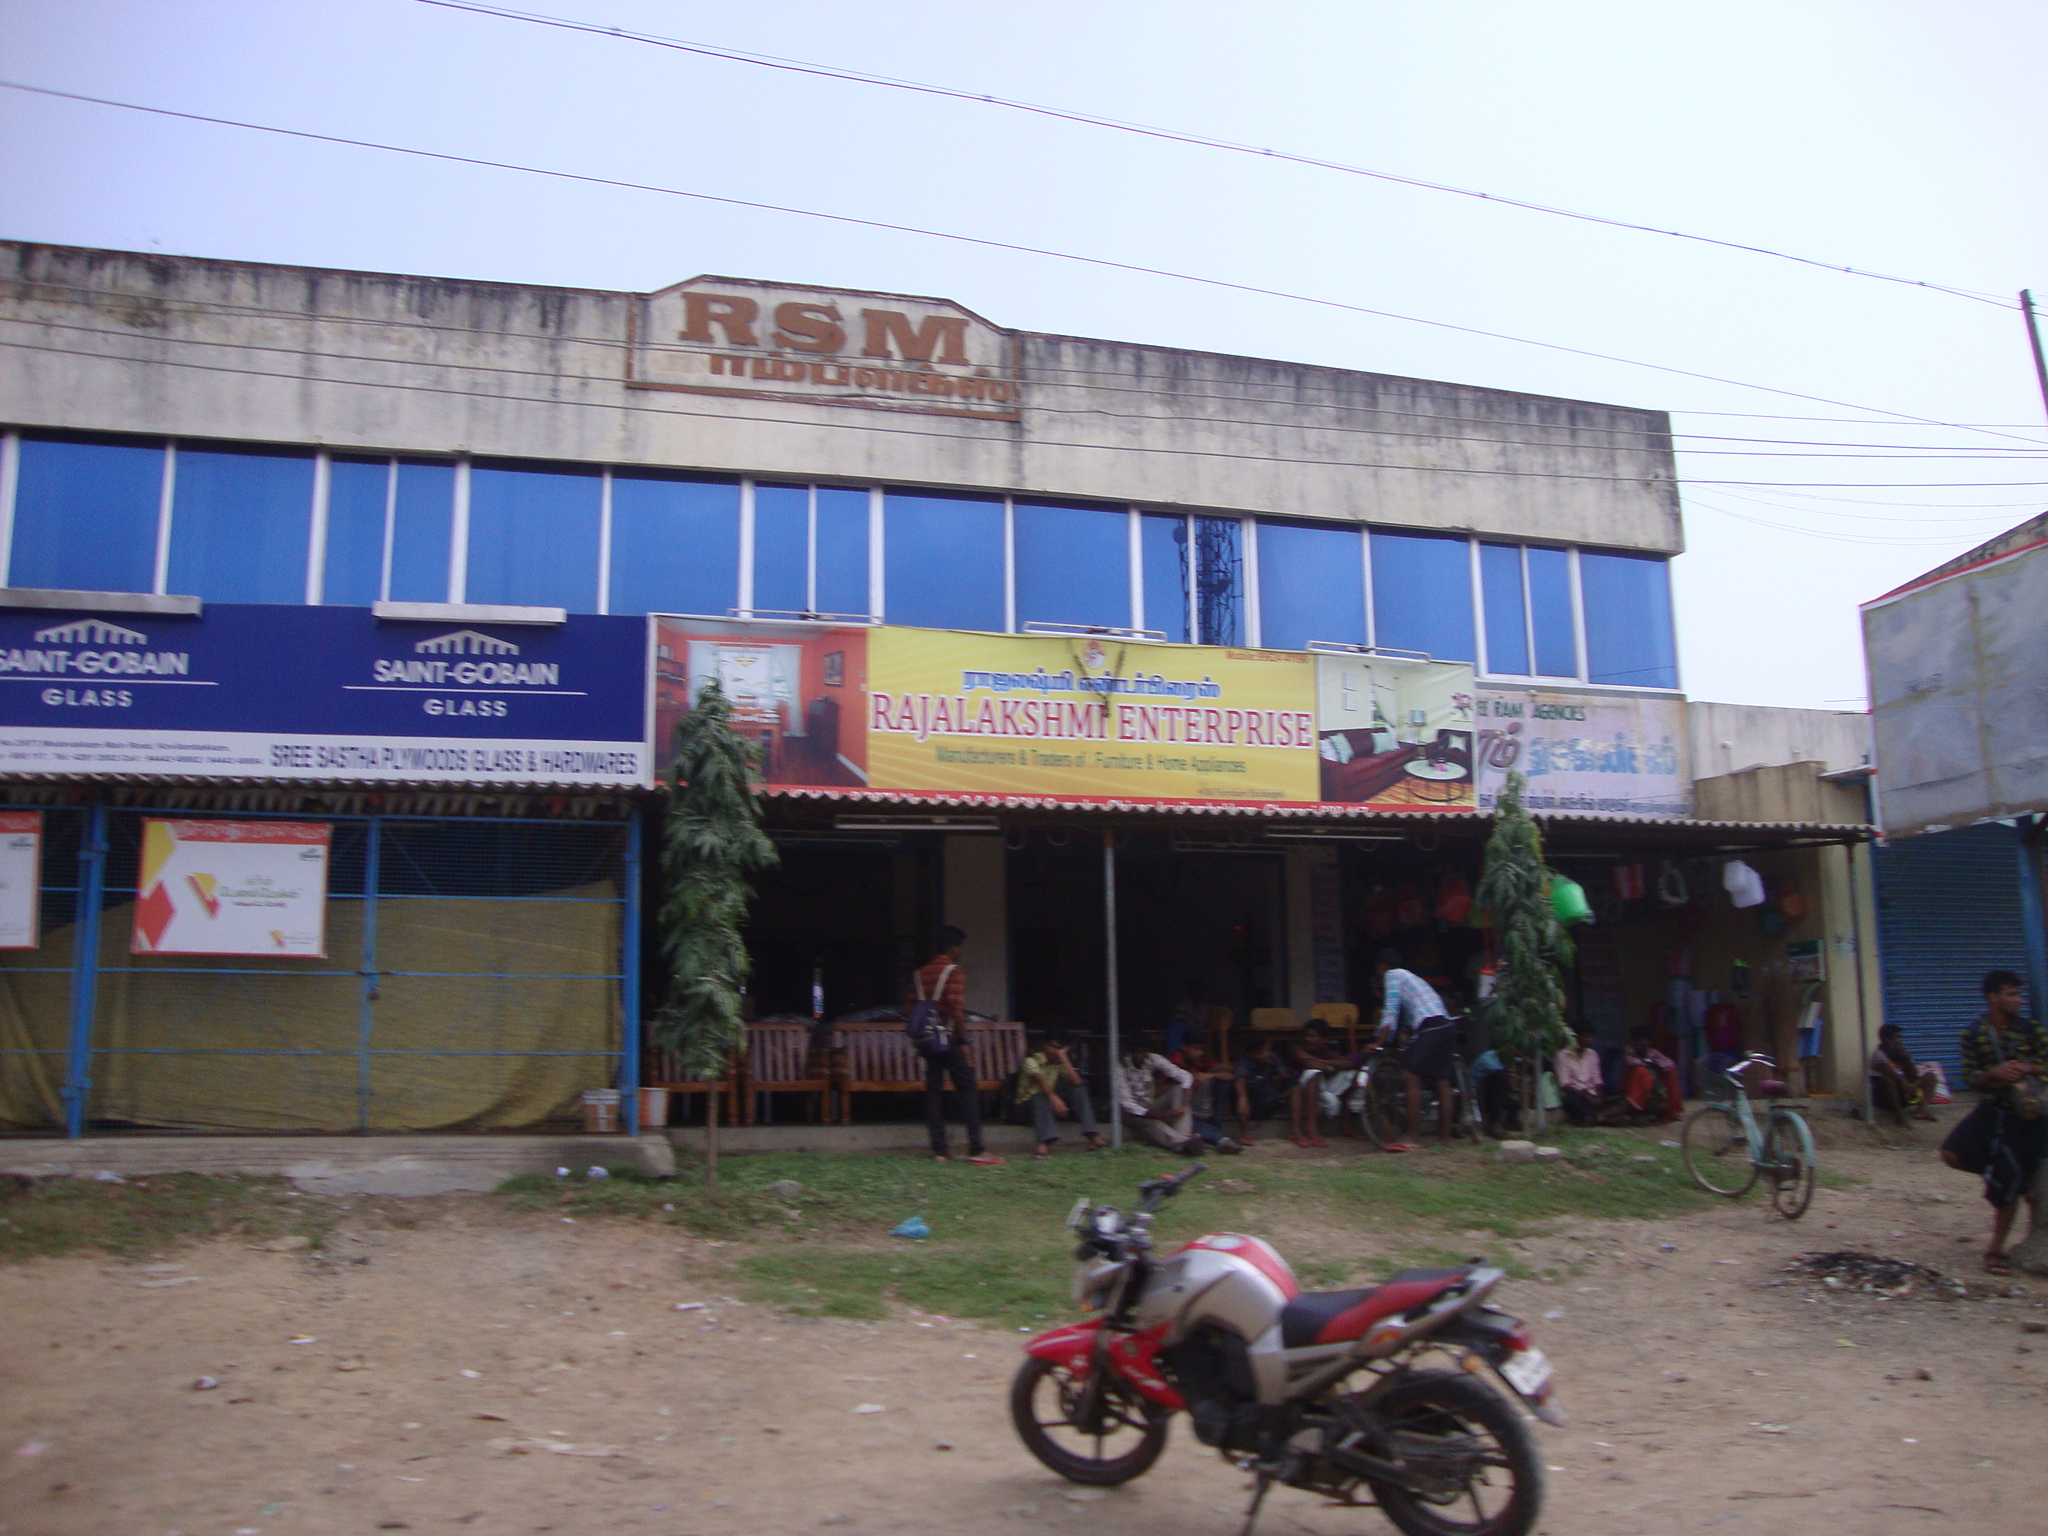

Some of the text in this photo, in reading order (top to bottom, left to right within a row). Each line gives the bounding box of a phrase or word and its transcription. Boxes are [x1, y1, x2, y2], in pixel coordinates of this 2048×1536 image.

[680, 291, 970, 366] RSM
[373, 659, 560, 686] SAINT-GOBAIN
[41, 688, 133, 707] GLASS
[423, 699, 508, 717] GLASS
[870, 692, 1315, 749] RAJALAKSHMI ENTERPRISE
[270, 744, 312, 769] SREE
[317, 745, 378, 770] SASTHA
[381, 747, 469, 772] PLYWOODS
[470, 749, 525, 773] GLASS
[540, 751, 639, 776] HARDWARES
[936, 746, 1016, 765] Manufacturers
[1096, 751, 1144, 769] Furniture
